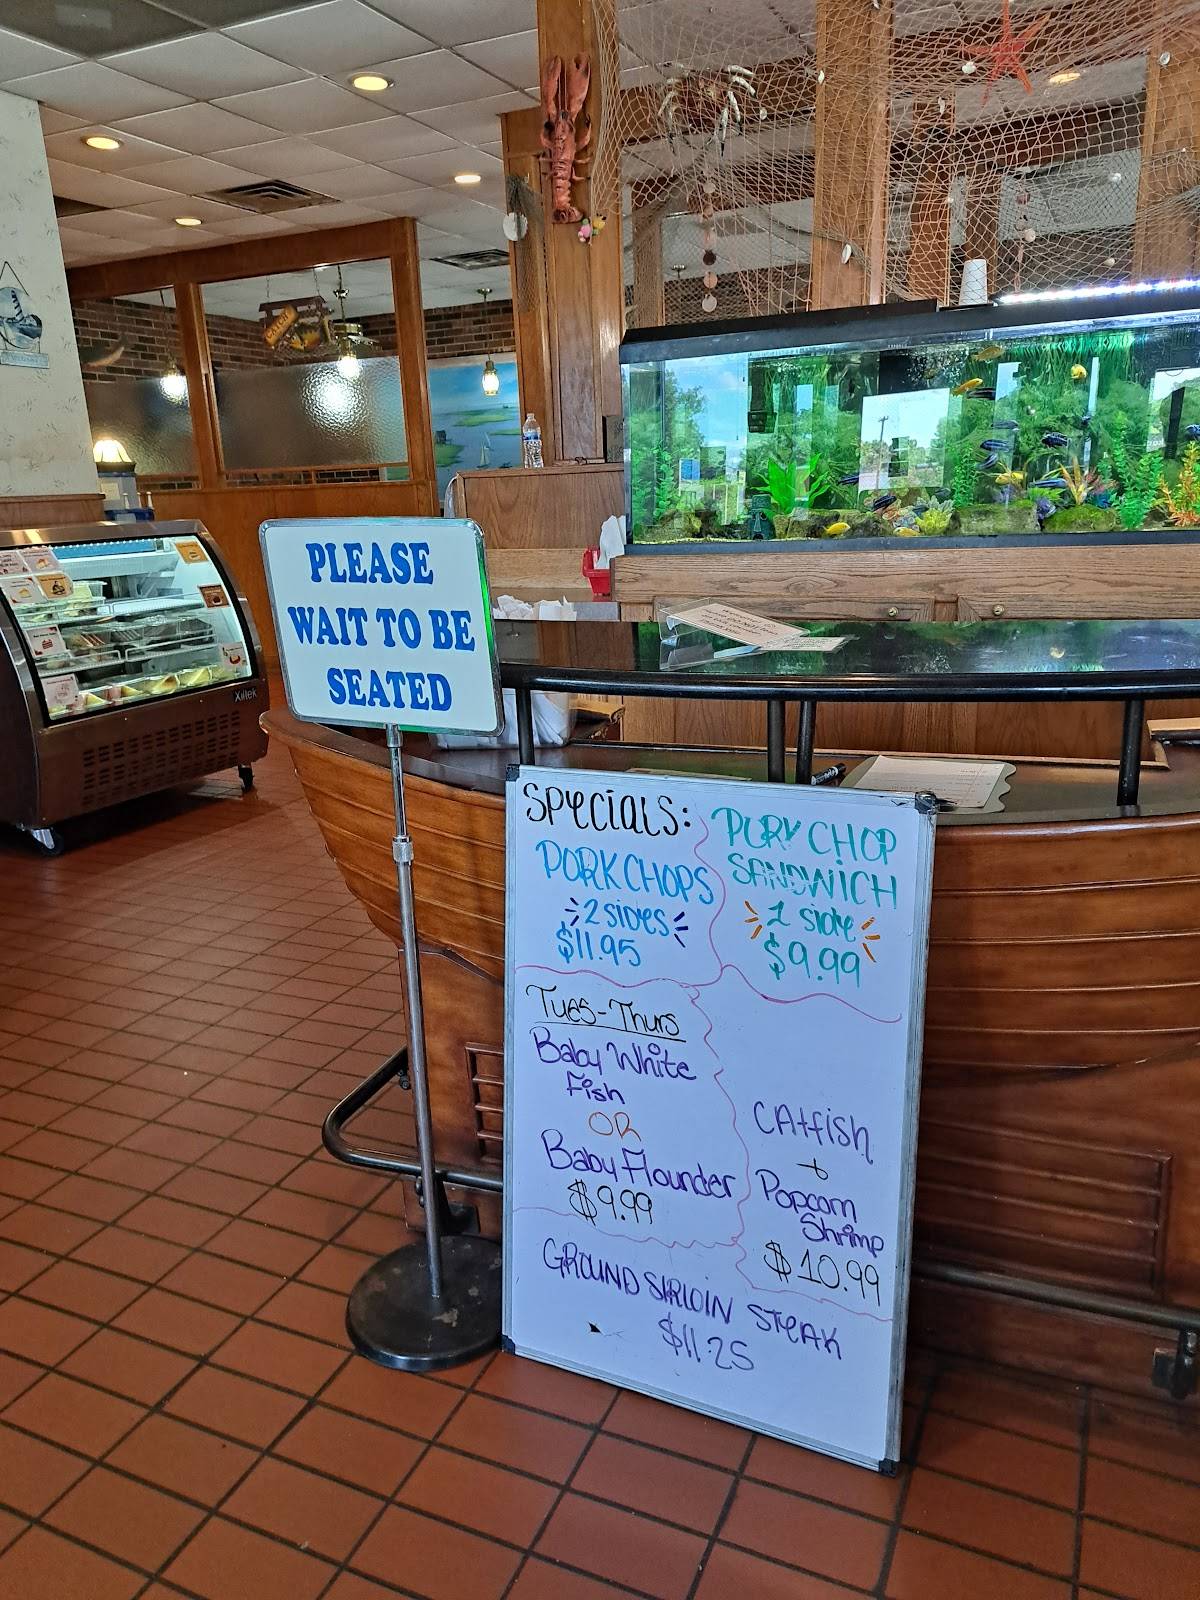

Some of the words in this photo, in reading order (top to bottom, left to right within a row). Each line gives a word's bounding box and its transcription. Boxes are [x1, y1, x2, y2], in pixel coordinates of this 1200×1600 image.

[265, 312, 289, 339] CATCH
[305, 542, 434, 585] PLEASE
[287, 606, 368, 646] WAIT
[375, 607, 422, 649] TO
[428, 609, 476, 651] BE
[326, 667, 453, 712] SEATED
[808, 820, 897, 865] CHOP
[535, 839, 622, 891] PORK
[623, 853, 714, 905] CHOPS
[727, 851, 897, 910] SANDWICH
[583, 898, 600, 925] 2
[556, 921, 641, 967] $11.95
[763, 931, 861, 988] $9.99
[529, 1025, 603, 1076] Baby
[606, 1041, 697, 1081] White
[566, 1070, 626, 1105] Fish
[588, 1111, 643, 1143] OR
[541, 1128, 619, 1183] Baby
[620, 1147, 737, 1199] Flounder
[567, 1178, 654, 1227] $9.99
[755, 1168, 857, 1224] Popcorn
[799, 1212, 885, 1259] Shrimp
[543, 1237, 640, 1296] GROUND
[658, 1311, 755, 1371] $11.25
